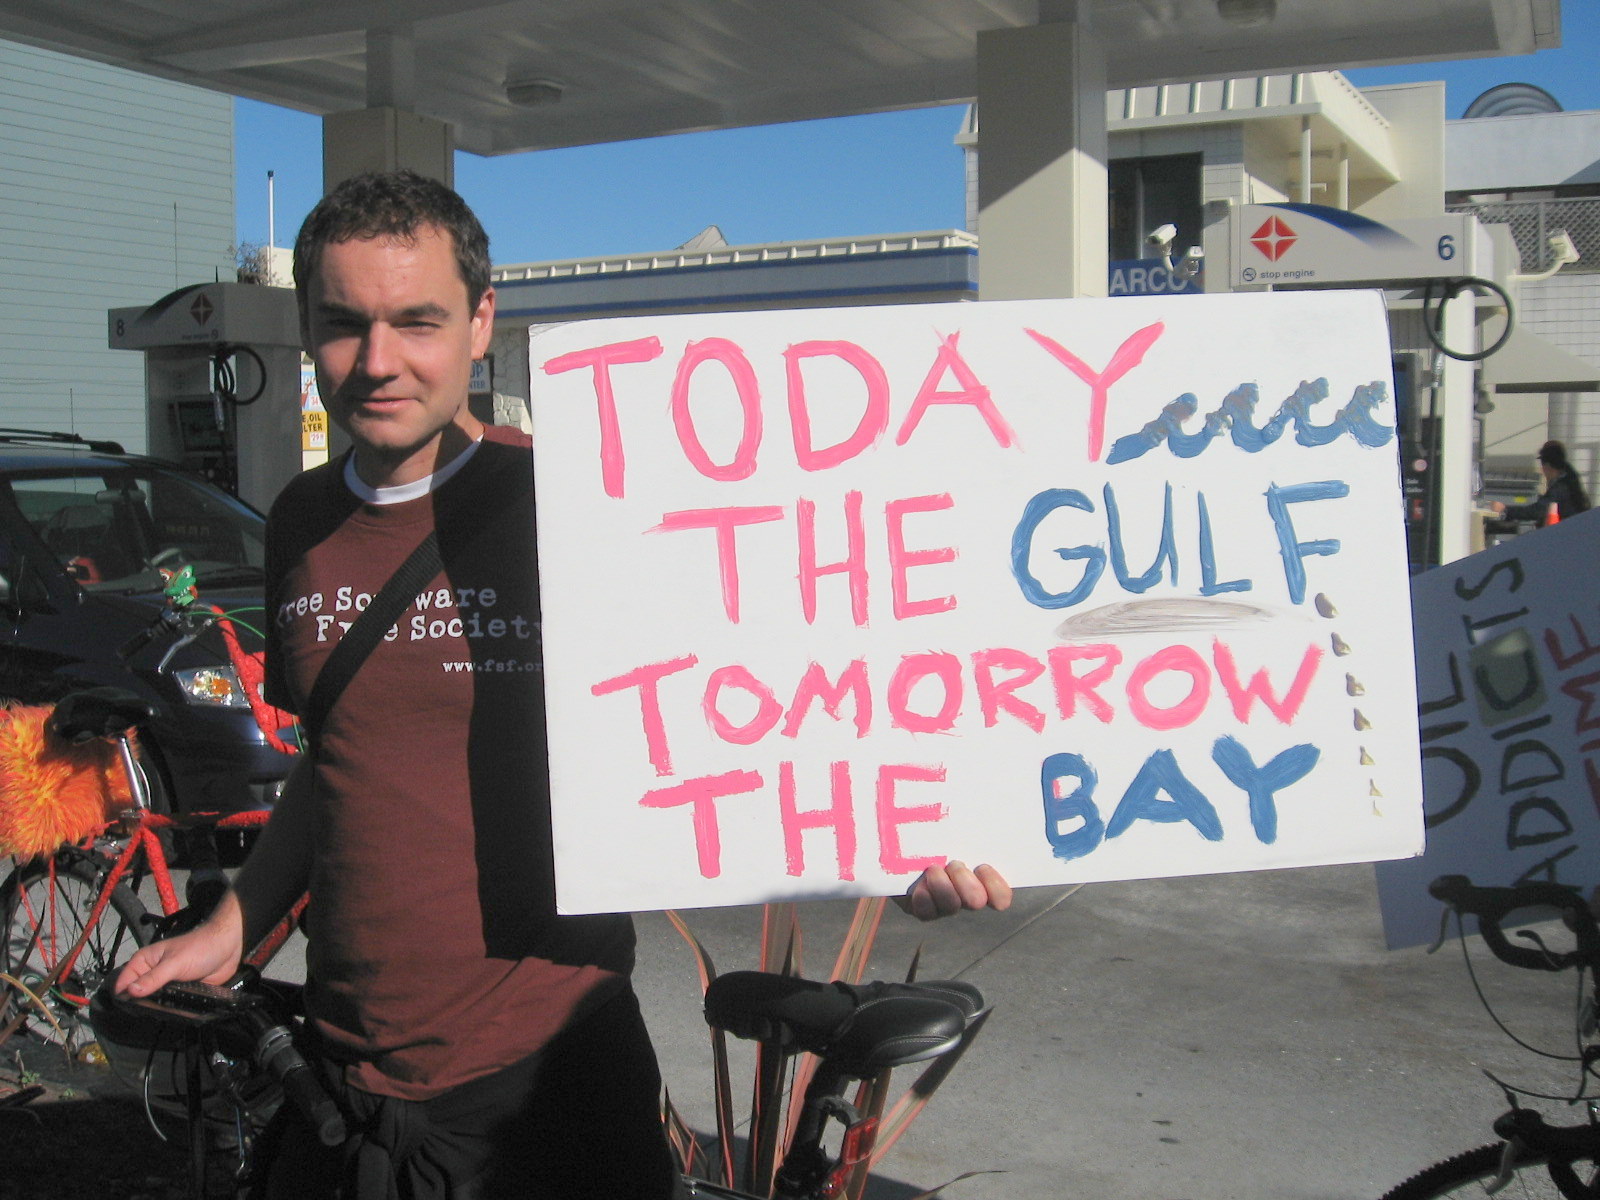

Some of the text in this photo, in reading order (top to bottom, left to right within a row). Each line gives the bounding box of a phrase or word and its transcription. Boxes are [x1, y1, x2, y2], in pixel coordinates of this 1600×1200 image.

[1109, 266, 1188, 294] ARCO
[1260, 269, 1315, 280] stop engine
[1437, 234, 1456, 261] 6
[116, 319, 125, 337] 8
[541, 320, 1165, 499] TODAY
[644, 480, 1351, 627] THE GULF
[316, 615, 399, 642] Fre
[336, 586, 497, 612] Soware
[591, 639, 1324, 776] TOMORROW
[1419, 651, 1482, 829] OIL
[1454, 557, 1583, 890] ADDICTS
[638, 735, 1322, 882] THE BAY
